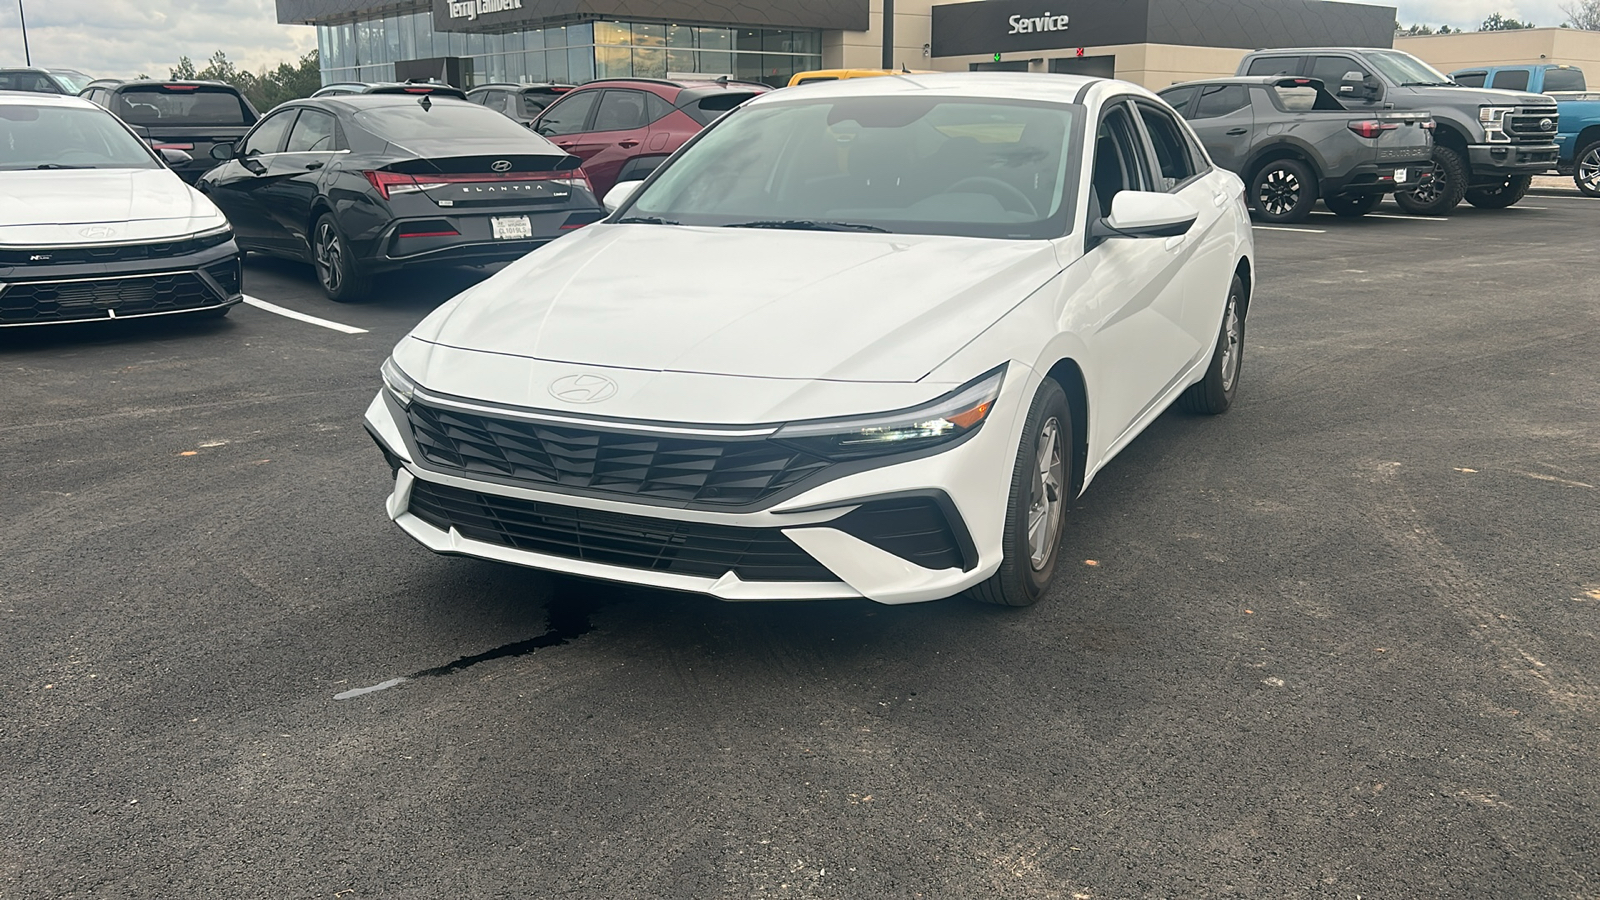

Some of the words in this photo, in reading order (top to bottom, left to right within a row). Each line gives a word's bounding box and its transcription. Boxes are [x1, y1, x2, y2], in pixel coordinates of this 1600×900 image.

[446, 0, 478, 21] Terry
[1008, 11, 1069, 35] Service
[462, 185, 543, 193] ELANTRA
